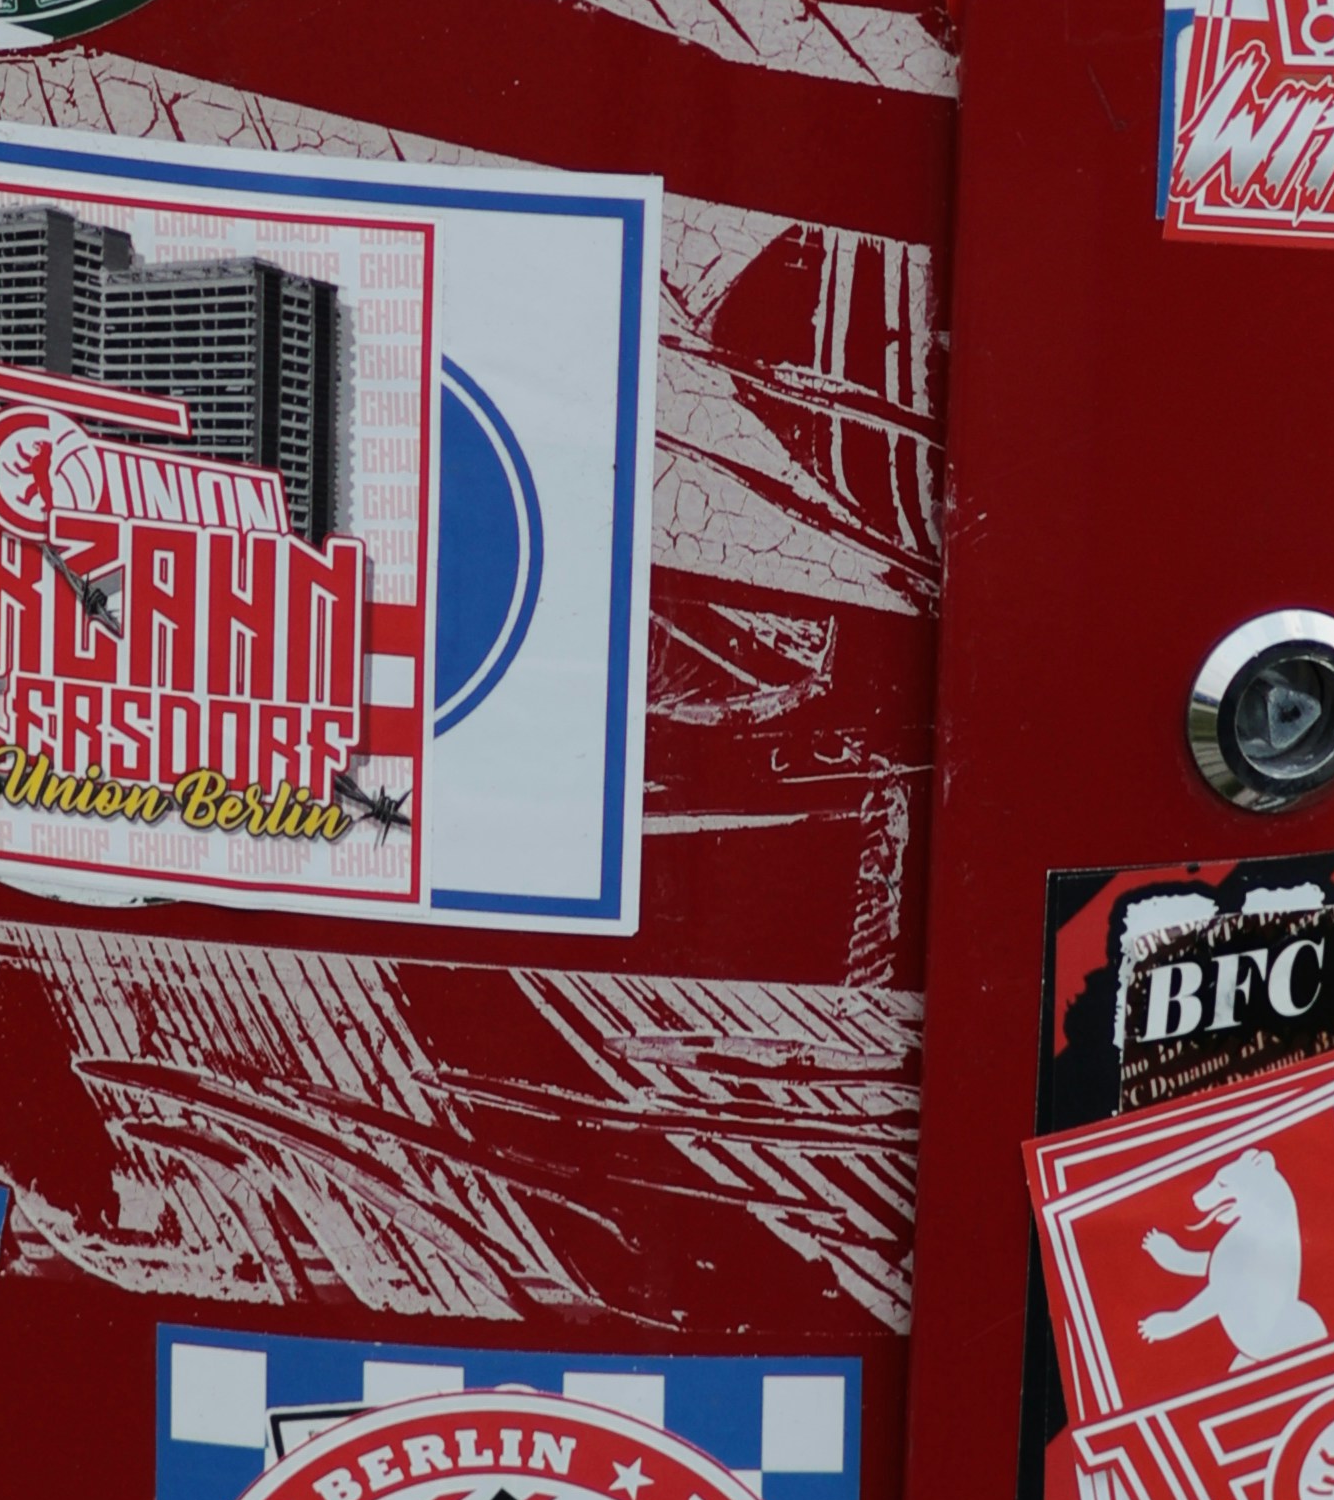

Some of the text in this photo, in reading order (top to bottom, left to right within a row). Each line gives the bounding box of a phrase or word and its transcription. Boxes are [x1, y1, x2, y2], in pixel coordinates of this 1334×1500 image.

[99, 446, 281, 533] UNION
[174, 766, 354, 842] Berlin
[1136, 938, 1326, 1044] BFC
